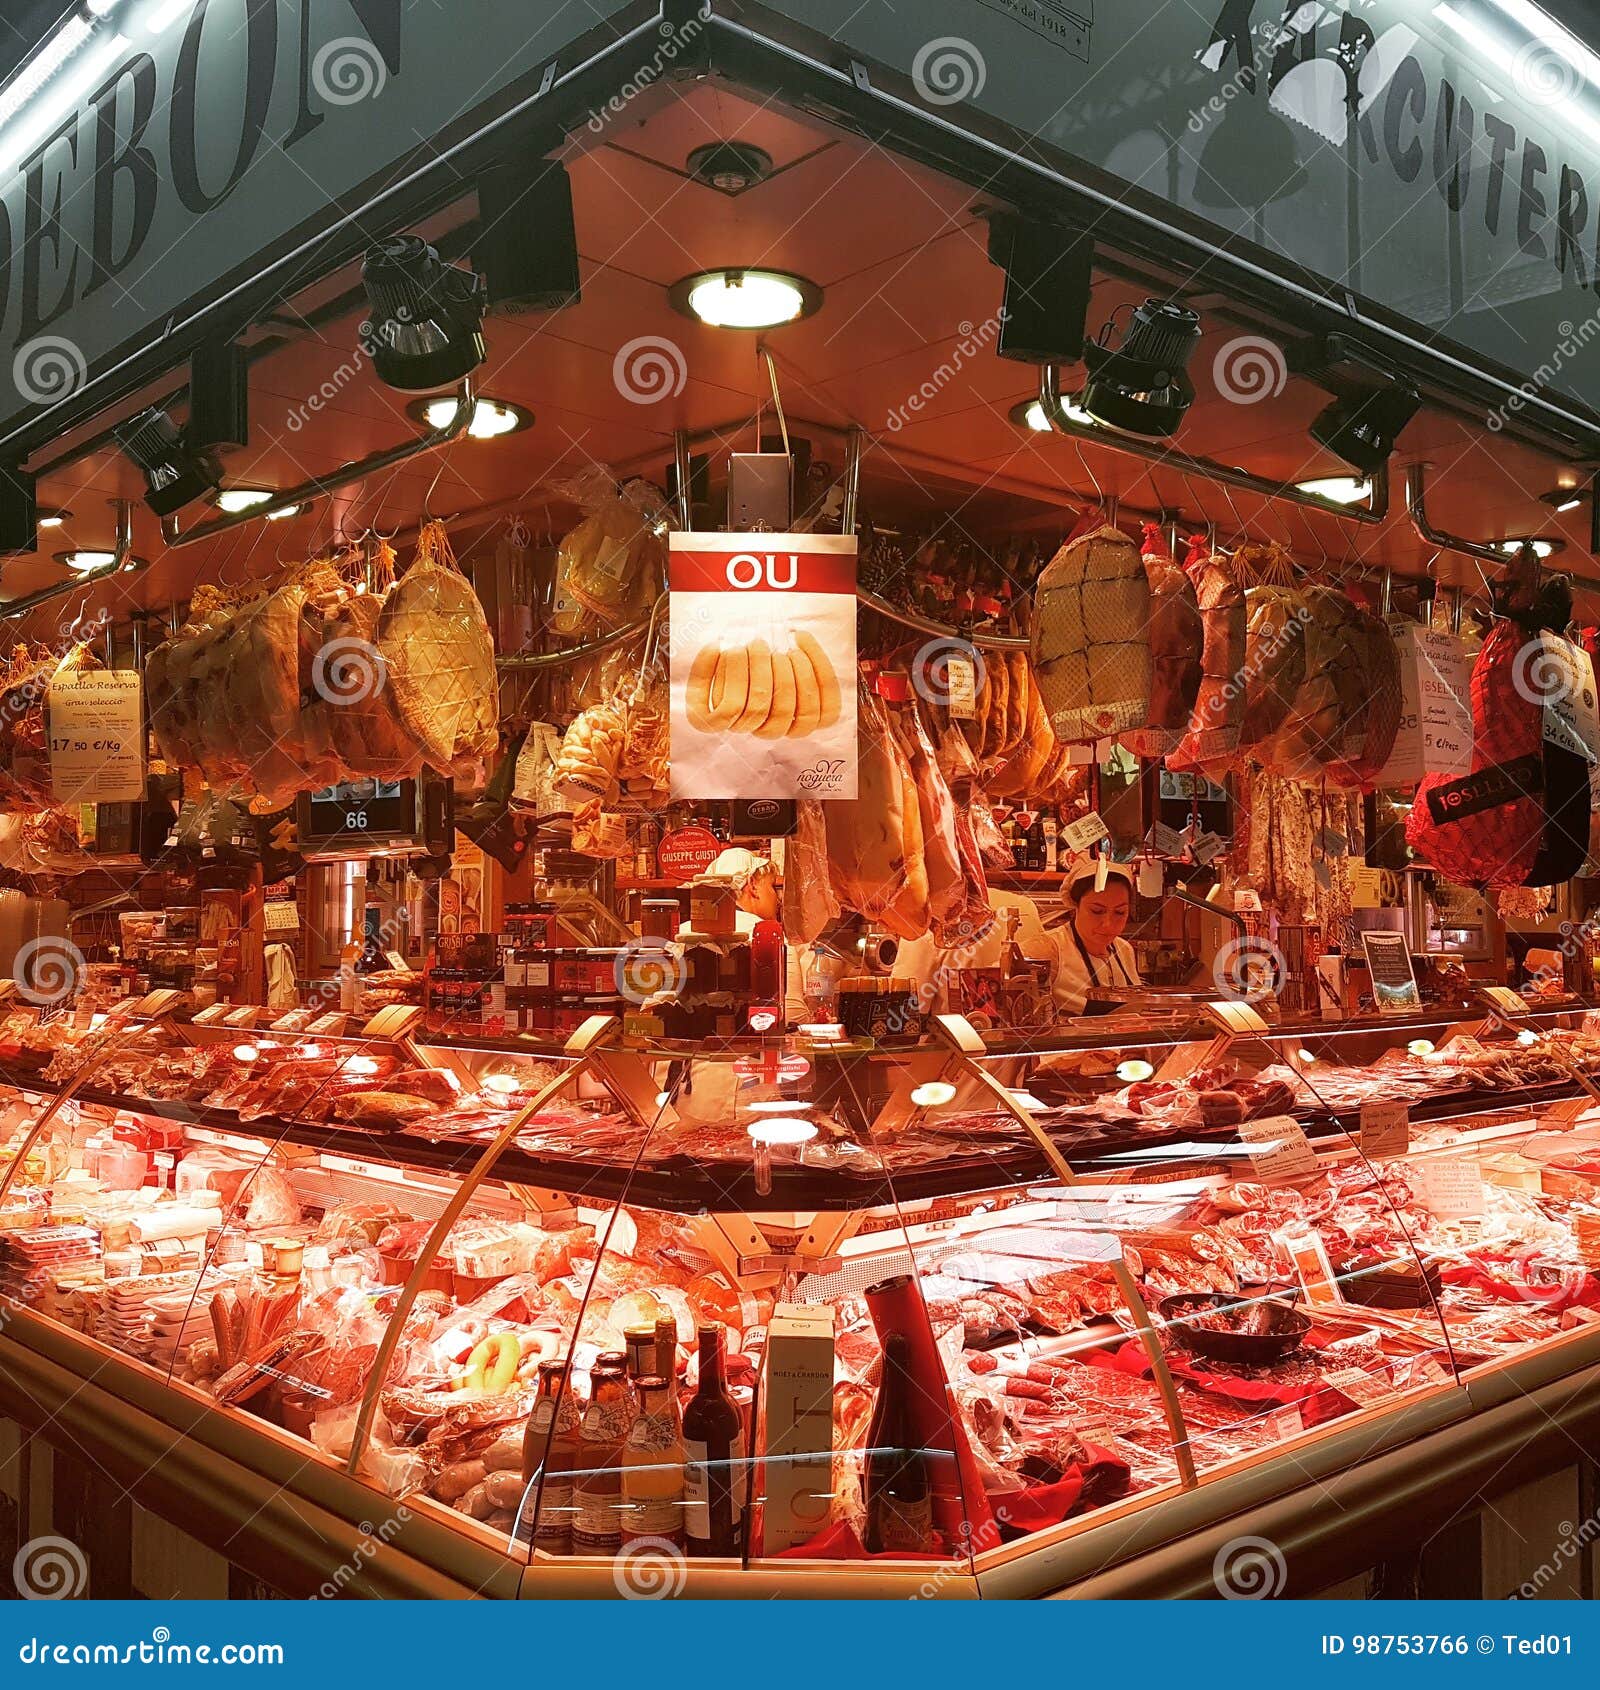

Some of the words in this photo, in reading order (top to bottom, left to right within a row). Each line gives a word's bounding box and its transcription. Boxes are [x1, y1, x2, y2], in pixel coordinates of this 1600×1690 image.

[1041, 14, 1067, 37] 1918
[726, 554, 799, 589] OU
[52, 681, 95, 692] Espatlla
[96, 681, 138, 690] Reserva
[93, 740, 121, 752] €/Kg
[797, 771, 843, 789] noguera
[346, 811, 368, 829] 66
[661, 851, 694, 863] GIUSEPPE
[695, 849, 717, 861] GIUSTI
